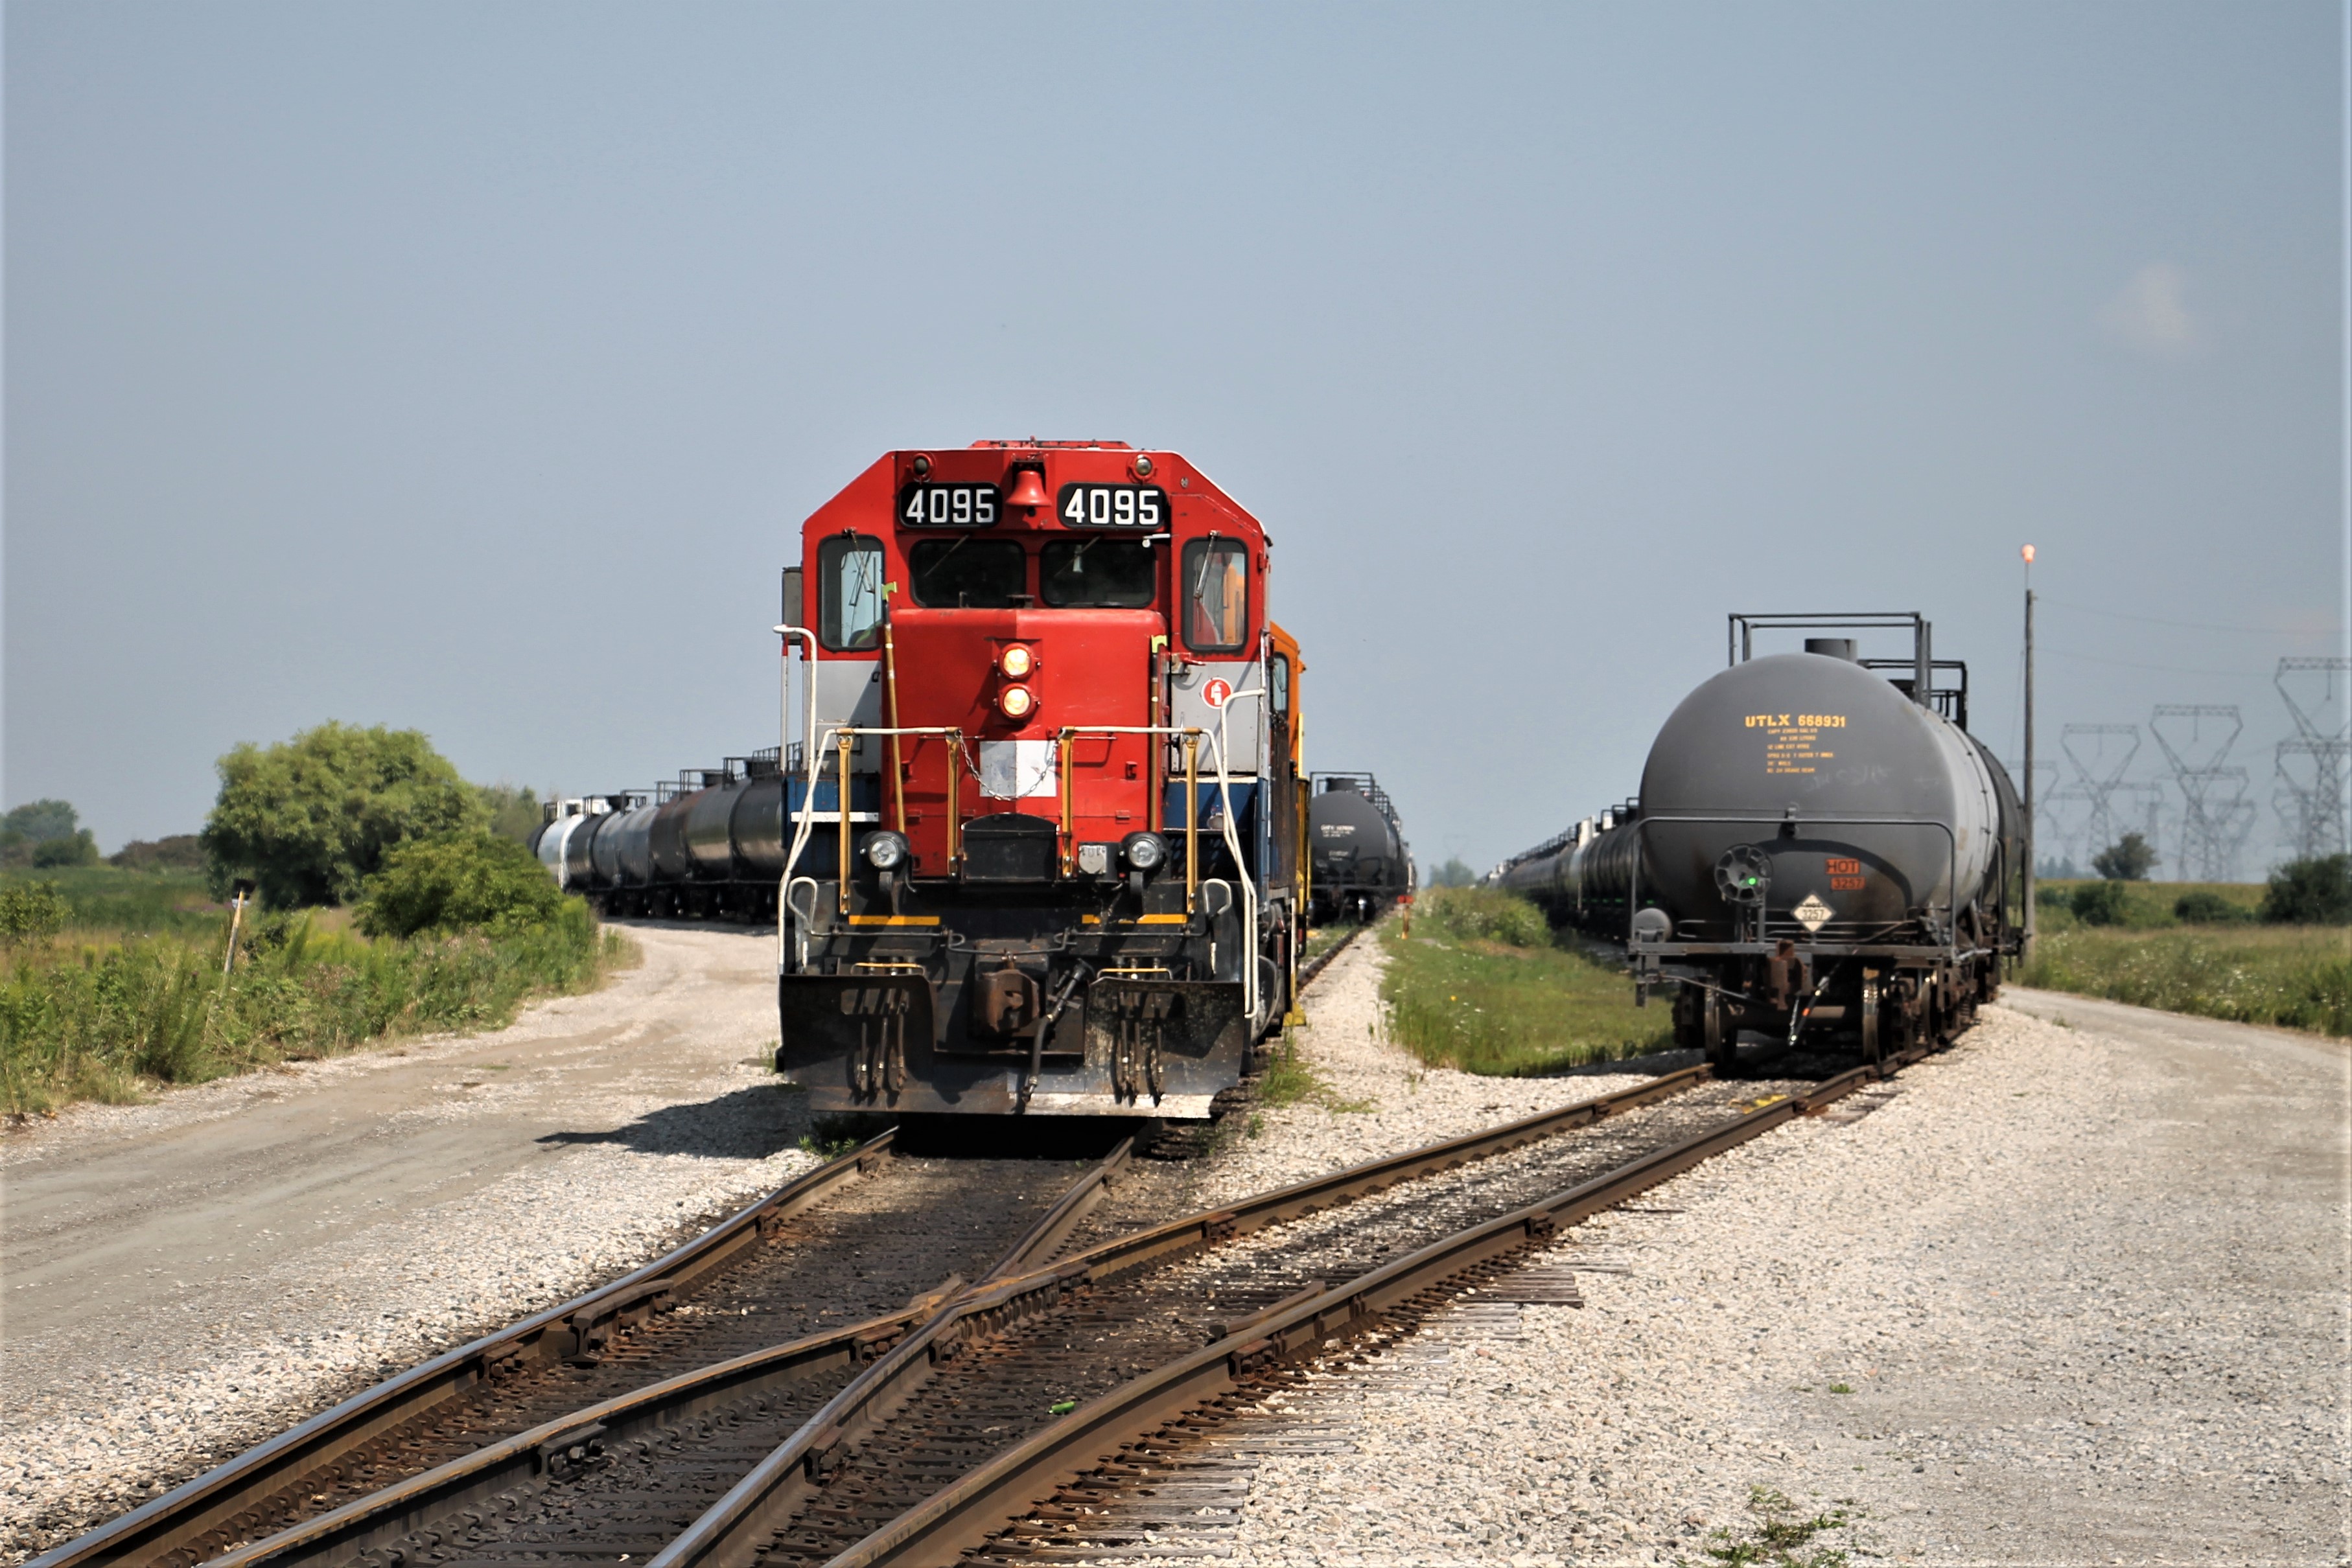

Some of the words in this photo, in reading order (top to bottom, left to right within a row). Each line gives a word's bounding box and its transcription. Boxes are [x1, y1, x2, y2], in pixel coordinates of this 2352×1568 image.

[905, 489, 995, 524] 4095
[1065, 488, 1159, 525] 4095
[1745, 714, 1791, 728] UTLX
[1798, 715, 1846, 728] 668931
[1826, 860, 1856, 873] HOT
[1834, 878, 1862, 889] 3257
[1802, 909, 1824, 919] 3257
